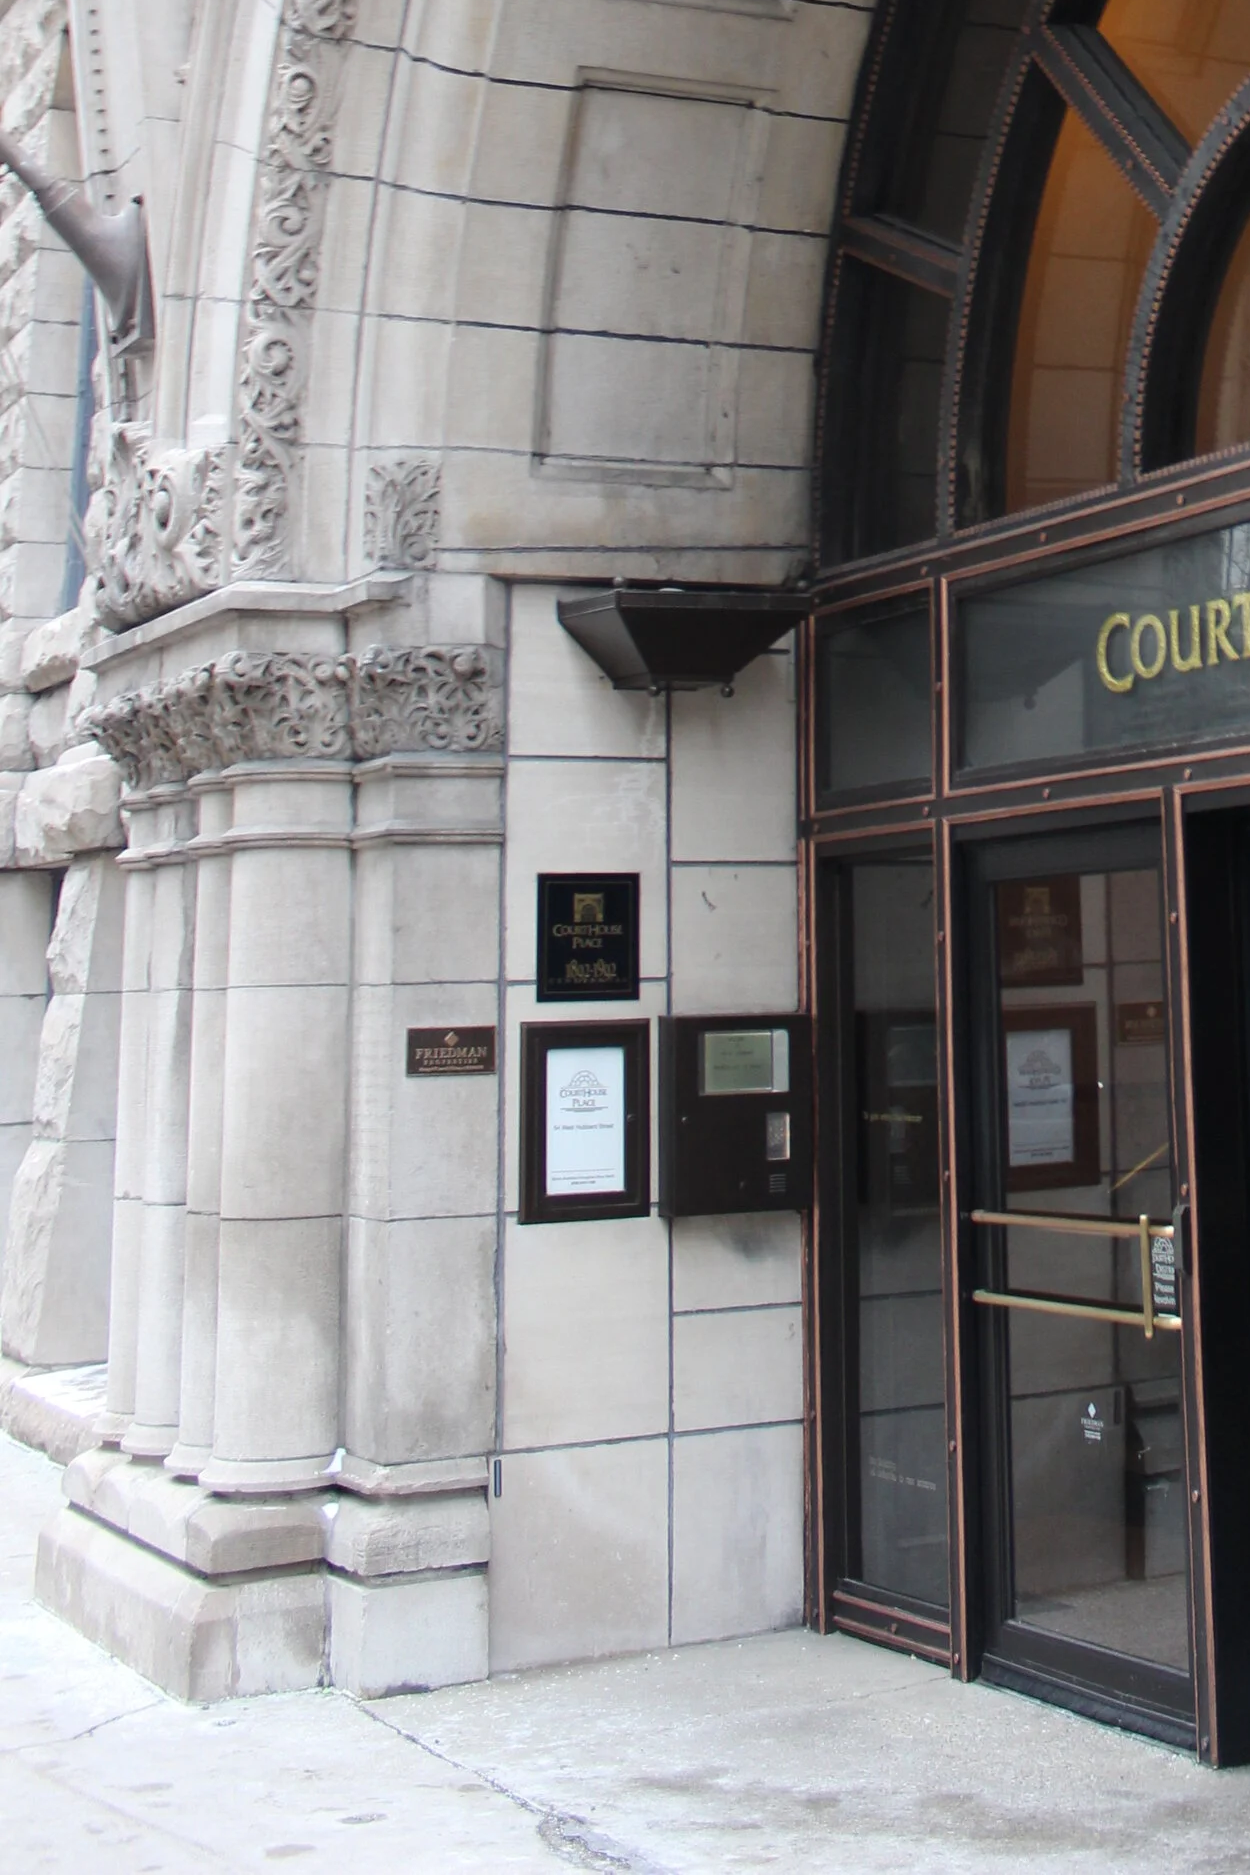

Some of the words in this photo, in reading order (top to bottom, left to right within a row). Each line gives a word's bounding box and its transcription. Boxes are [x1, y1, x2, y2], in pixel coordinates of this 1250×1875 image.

[572, 936, 603, 949] PLACE
[414, 1046, 488, 1060] FRIEDMAN
[572, 1098, 596, 1108] PLACE
